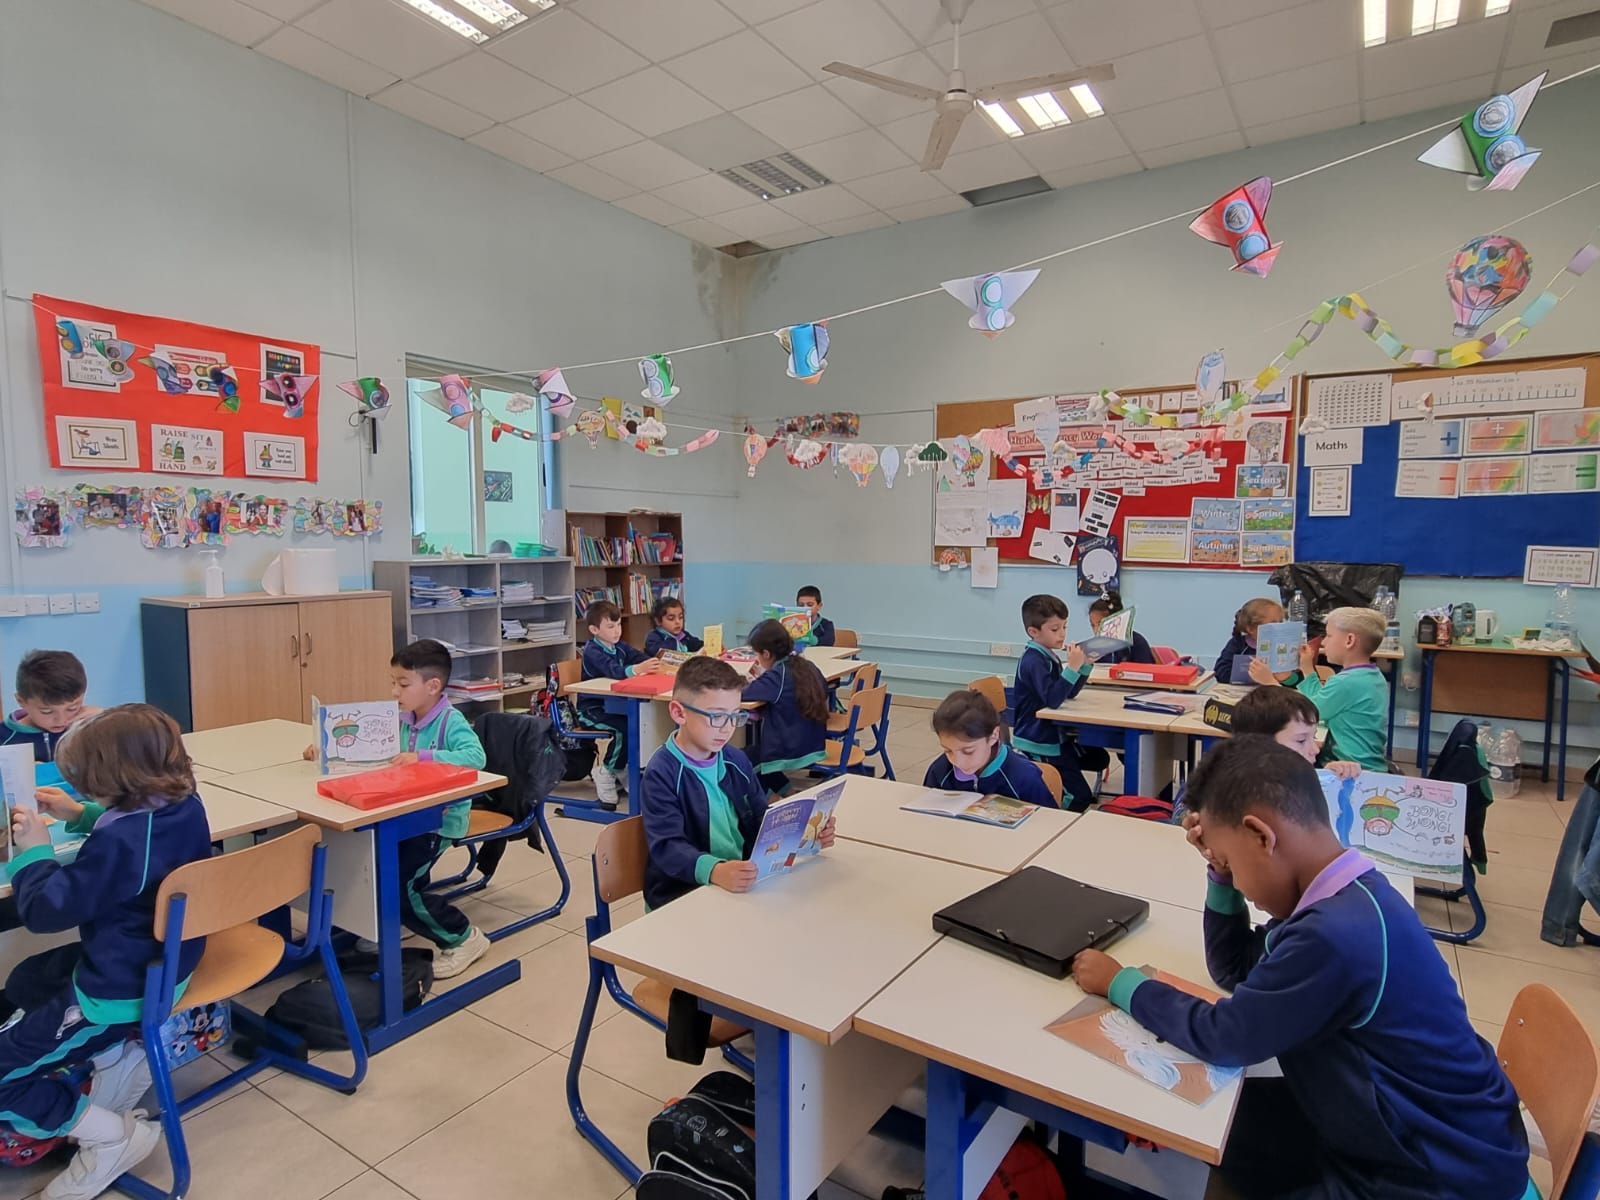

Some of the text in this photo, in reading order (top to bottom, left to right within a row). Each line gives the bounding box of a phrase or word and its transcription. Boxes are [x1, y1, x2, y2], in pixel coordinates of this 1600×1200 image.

[160, 428, 188, 438] RAISE
[1010, 435, 1032, 446] High
[1315, 440, 1348, 451] Maths
[159, 462, 186, 471] HAND
[1243, 476, 1283, 485] Seasons
[1200, 509, 1232, 518] Winter
[1254, 510, 1284, 519] Spring
[1198, 541, 1234, 550] Autumn
[1406, 805, 1454, 822] BONGI
[1406, 817, 1452, 834] WONGI
